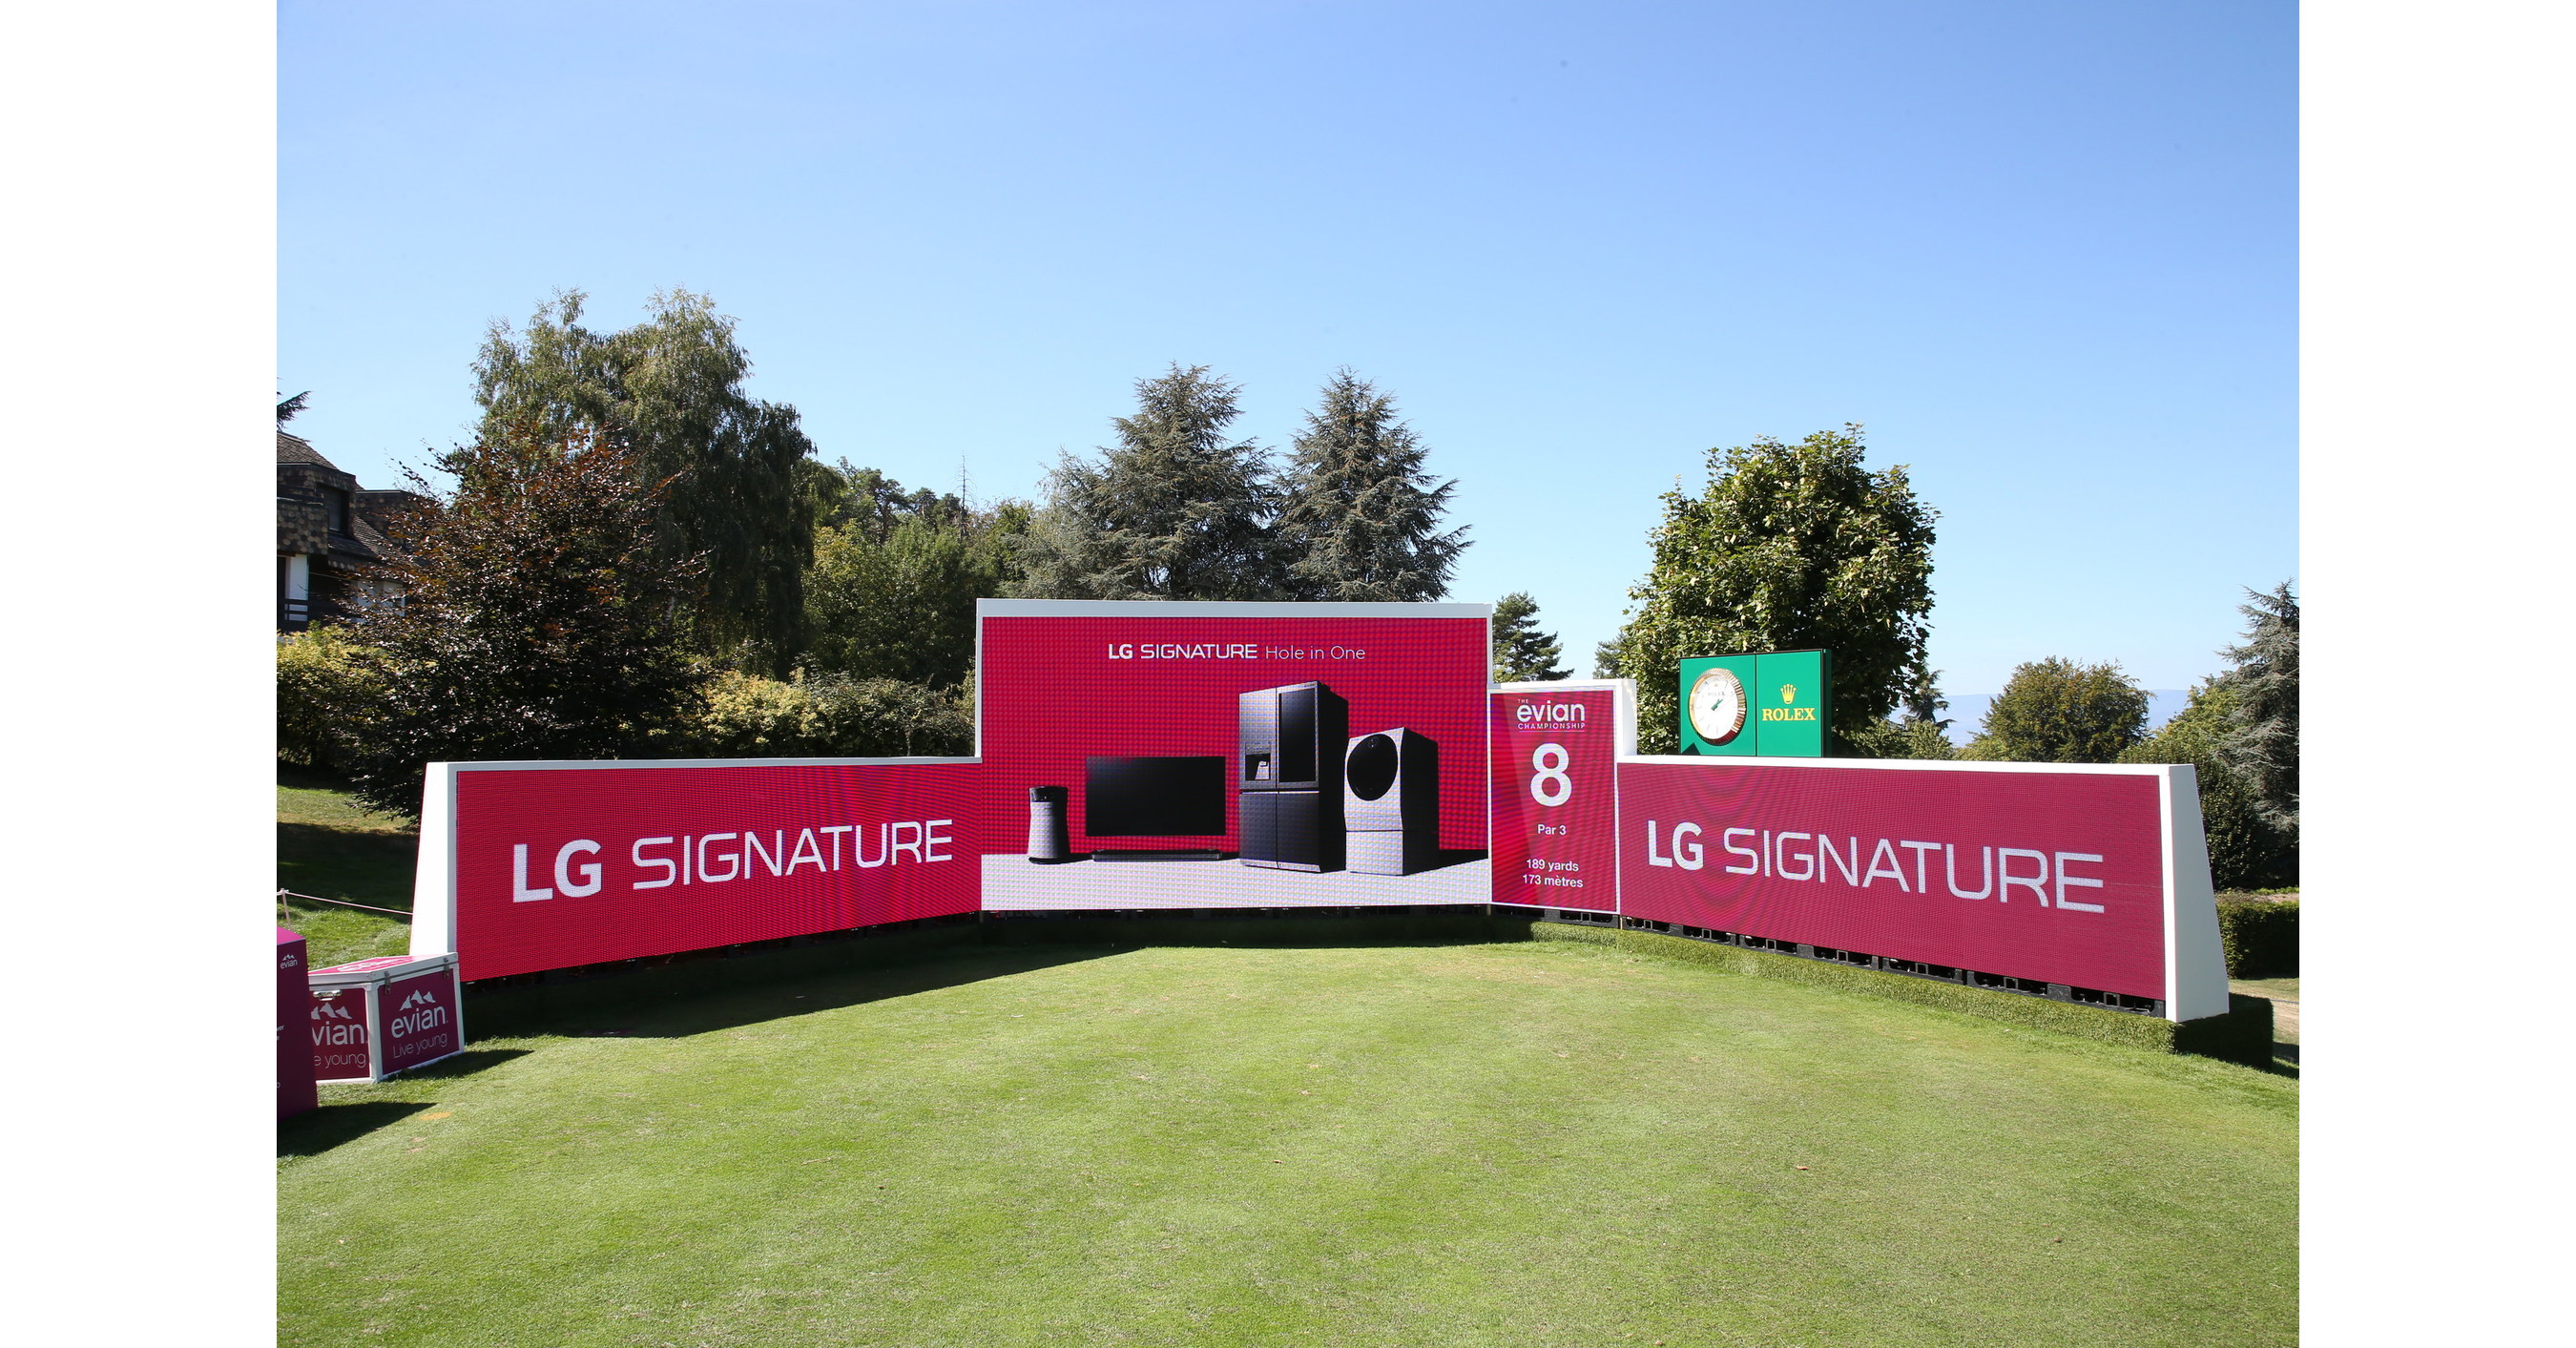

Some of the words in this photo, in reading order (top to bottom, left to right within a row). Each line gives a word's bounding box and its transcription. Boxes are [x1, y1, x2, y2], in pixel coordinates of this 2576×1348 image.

[1109, 643, 1132, 660] LG
[1139, 643, 1257, 660] SIGNATURE
[1265, 645, 1305, 660] Hole
[1310, 645, 1324, 660] in
[1331, 645, 1365, 660] One
[1517, 700, 1585, 721] evian
[1762, 708, 1816, 721] ROLEX
[1530, 743, 1572, 806] 8
[1537, 824, 1556, 835] Par
[1559, 825, 1567, 836] 3
[512, 840, 602, 903] LG
[633, 819, 952, 890] SIGNATURE
[1526, 859, 1546, 870] 189
[1548, 861, 1579, 872] yards
[1648, 819, 1704, 870] LG
[1723, 828, 2105, 913] SIGNATURE
[1522, 875, 1542, 885] 173
[1545, 875, 1583, 888] mètres
[280, 958, 298, 968] evian
[312, 1021, 364, 1046] vian
[393, 1043, 414, 1059] Live
[416, 1032, 448, 1056] young
[324, 1052, 366, 1068] young
